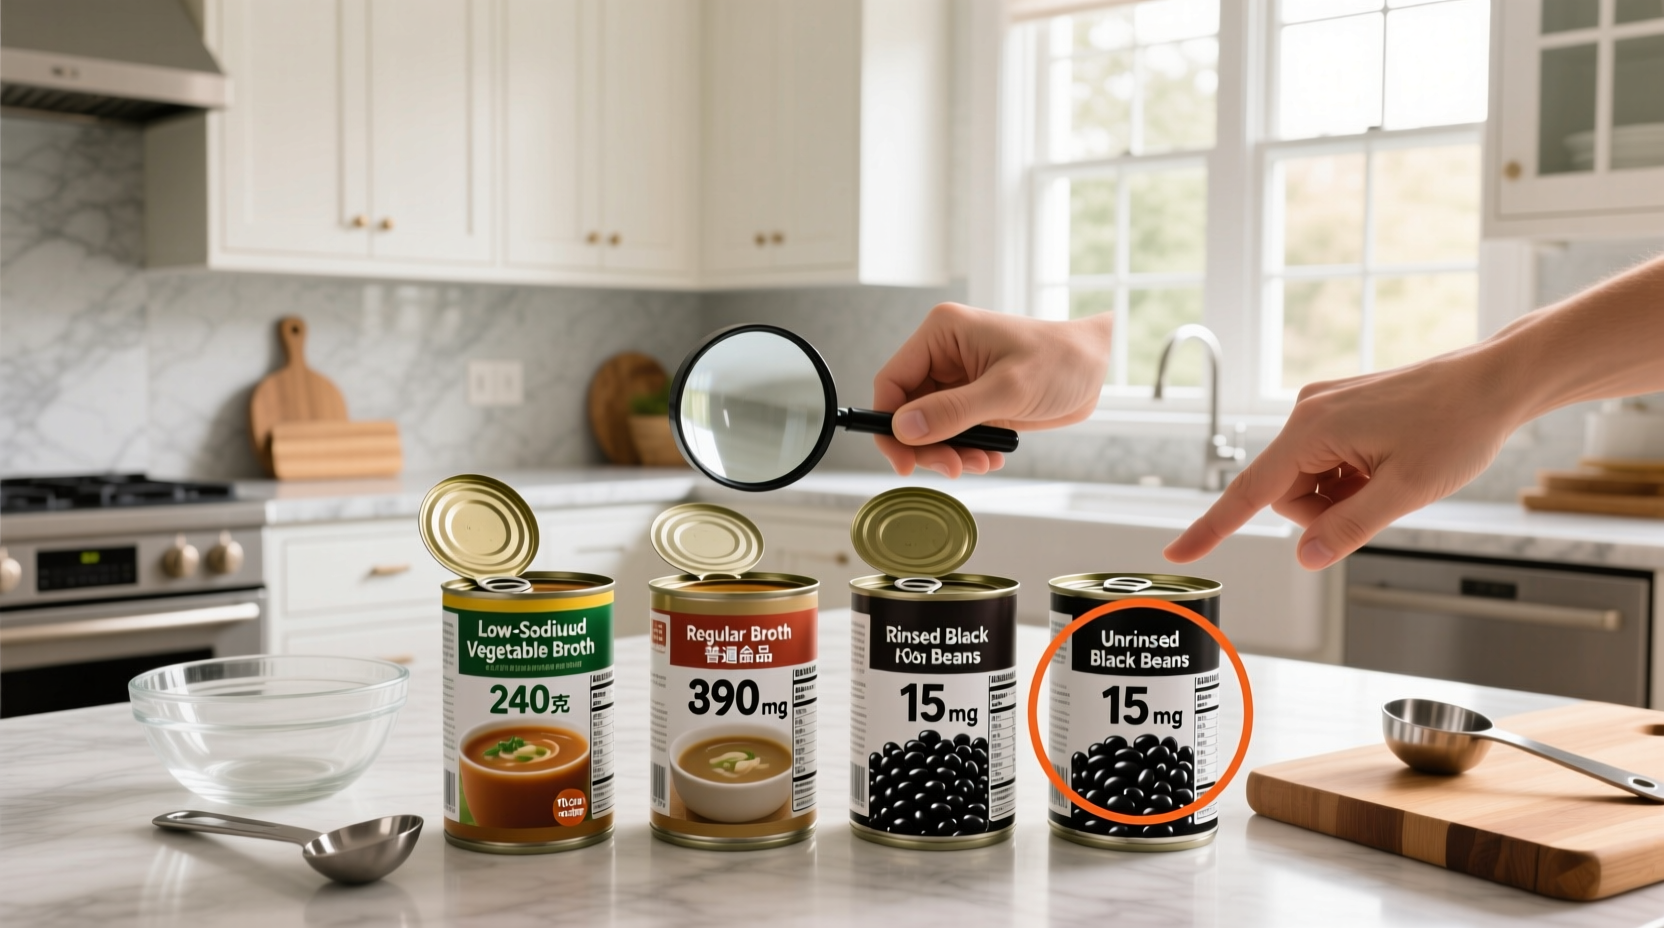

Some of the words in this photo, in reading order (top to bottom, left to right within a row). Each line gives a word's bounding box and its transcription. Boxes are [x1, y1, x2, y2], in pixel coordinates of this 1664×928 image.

[686, 624, 746, 645] Regular
[751, 623, 792, 642] Broth
[886, 625, 941, 645] Rinsed
[945, 625, 989, 645] Black
[1101, 630, 1180, 648] Unrinsed
[467, 640, 549, 664] Vegetable
[552, 637, 595, 658] Broth
[931, 648, 981, 665] Beans
[1090, 650, 1136, 668] Black
[1140, 652, 1190, 669] Beans
